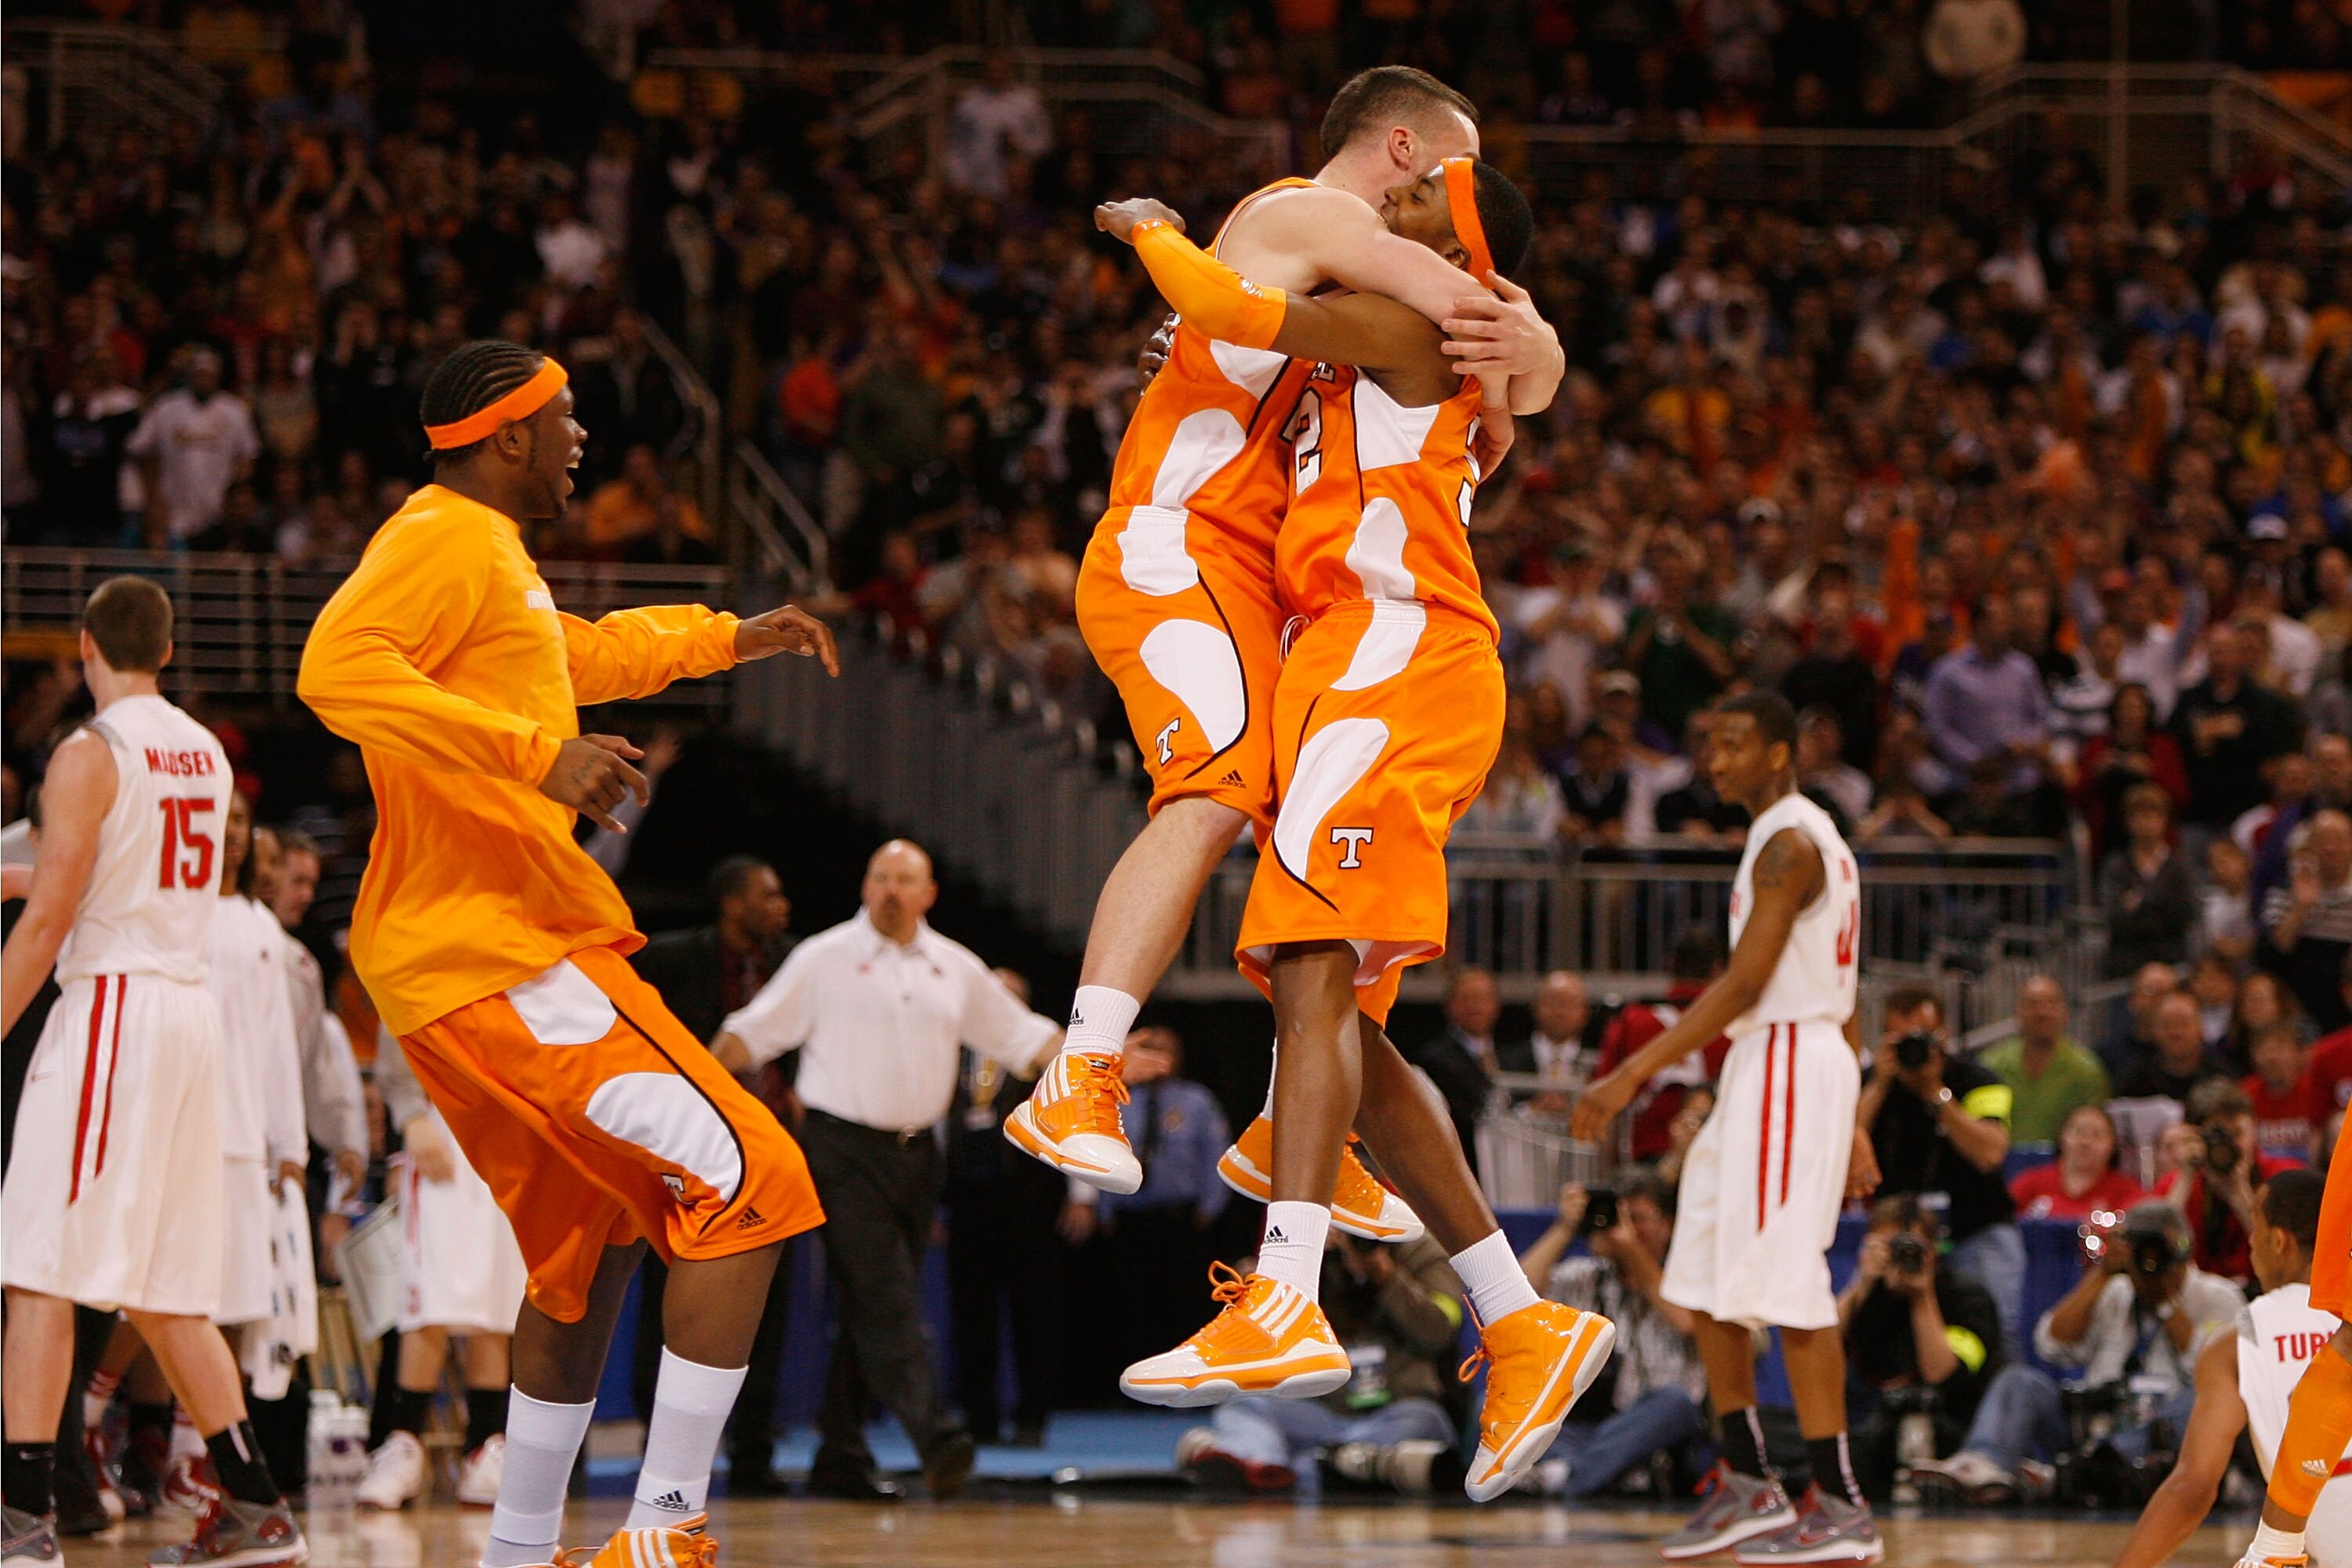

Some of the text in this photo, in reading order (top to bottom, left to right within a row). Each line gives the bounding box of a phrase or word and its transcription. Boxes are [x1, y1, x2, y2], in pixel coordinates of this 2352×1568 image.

[1156, 717, 1181, 767] T
[158, 797, 215, 889] 15
[1330, 827, 1374, 869] T
[736, 1218, 767, 1231] adidas
[2274, 1331, 2333, 1362] TUR
